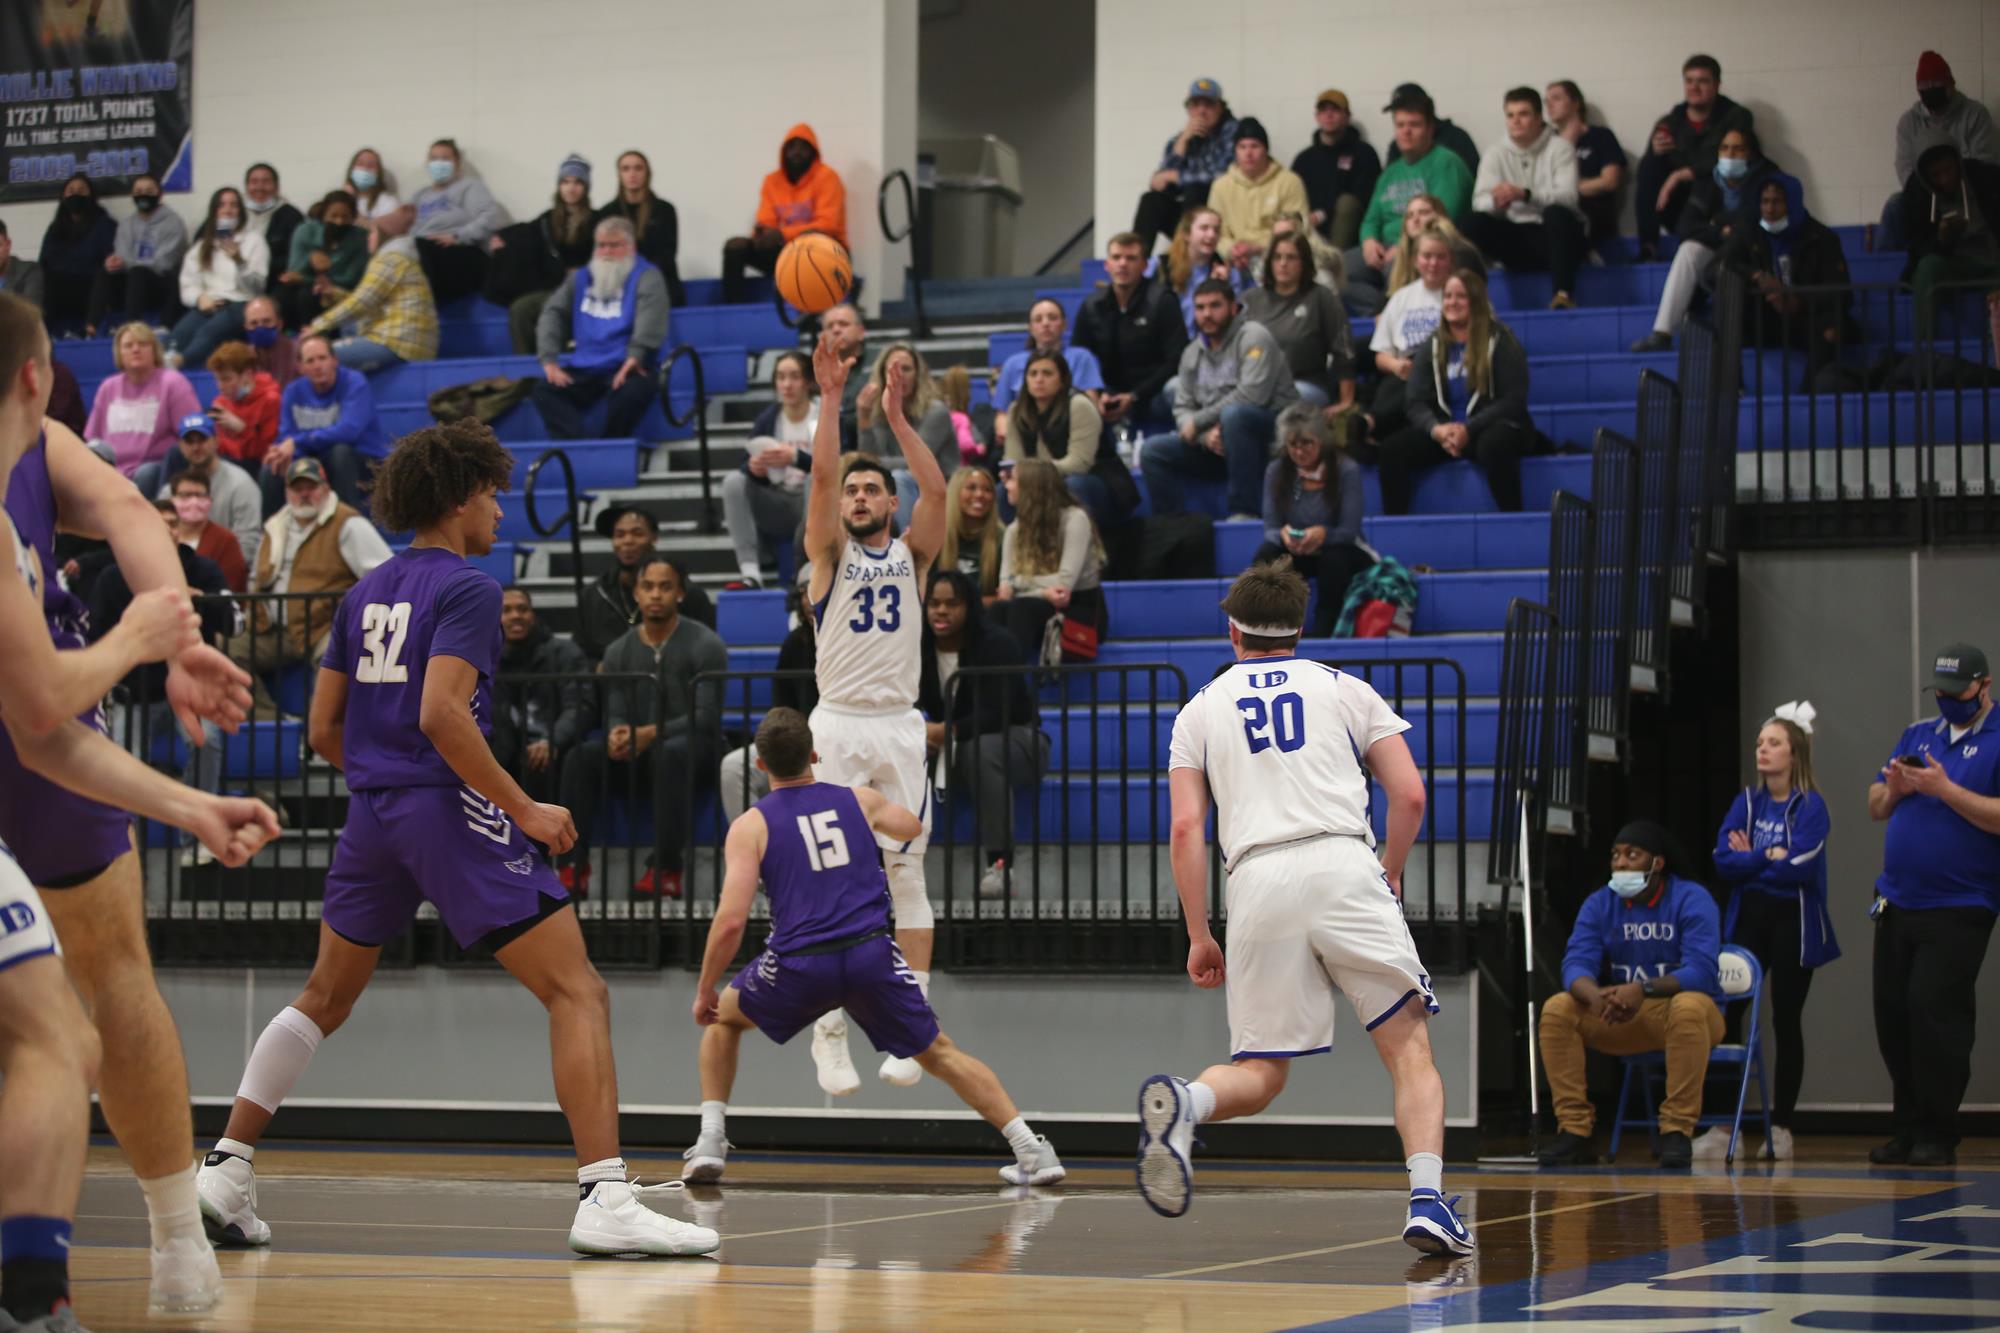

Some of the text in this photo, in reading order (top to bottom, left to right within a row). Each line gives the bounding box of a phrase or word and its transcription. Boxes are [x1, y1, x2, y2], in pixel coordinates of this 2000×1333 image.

[80, 61, 178, 96] WHITING
[6, 97, 155, 127] 1737 TOTAL POINTS
[5, 121, 156, 147] ALL TIME SCORING LEADER
[849, 584, 901, 633] 33
[355, 602, 412, 683] 32
[1246, 670, 1289, 689] UD
[1236, 691, 1306, 754] 20
[796, 808, 851, 872] 15
[1623, 922, 1674, 941] PROUD
